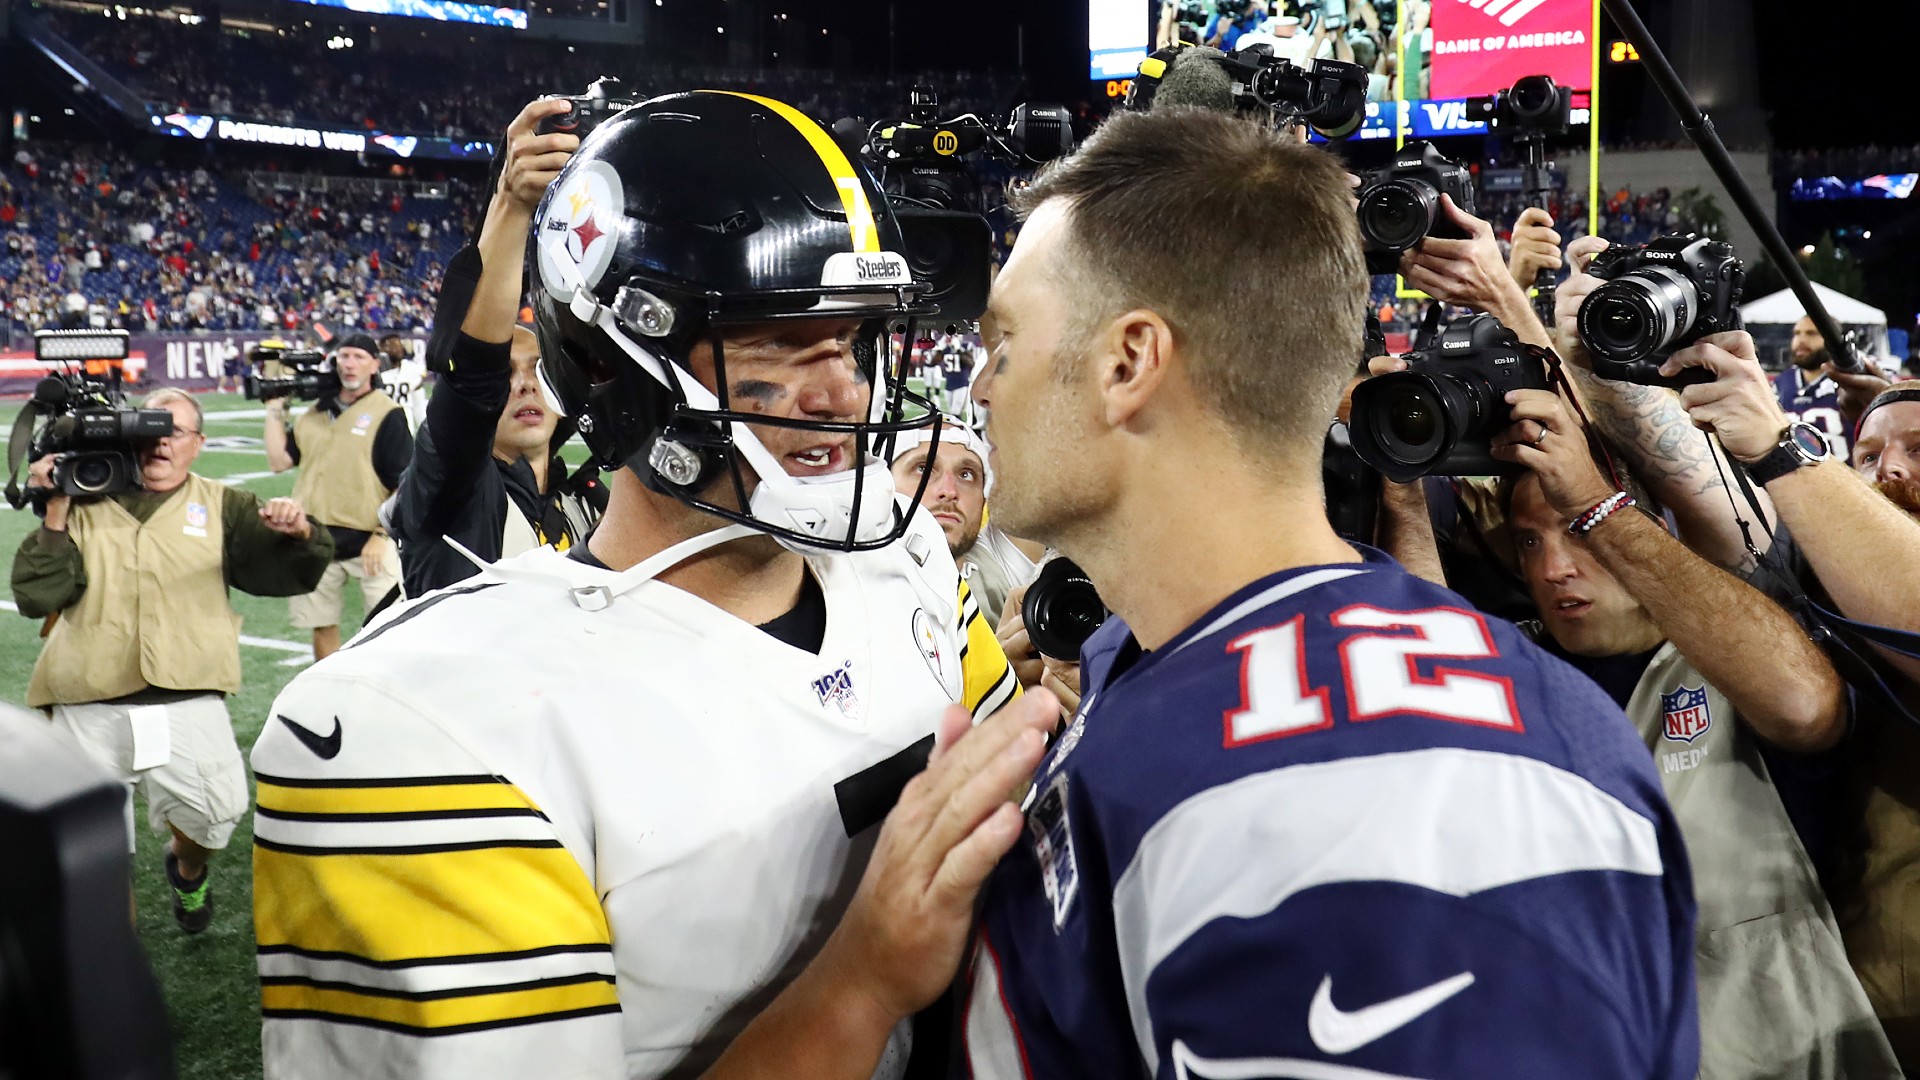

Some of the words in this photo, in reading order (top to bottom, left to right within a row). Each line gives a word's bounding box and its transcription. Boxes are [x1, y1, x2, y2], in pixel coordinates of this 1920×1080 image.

[1435, 38, 1480, 54] BANK
[1483, 36, 1506, 51] OF
[1507, 30, 1585, 49] AMERICA
[1321, 65, 1344, 73] SONY
[1031, 109, 1057, 118] Canon
[1421, 101, 1487, 130] VIS
[218, 119, 321, 148] PATRIOTS
[322, 131, 366, 152] WIN
[937, 135, 955, 151] DD
[912, 167, 939, 175] Canon
[1397, 159, 1422, 168] Canon
[1645, 251, 1677, 260] SONY
[856, 255, 902, 281] Steelers
[1442, 340, 1471, 349] Canon
[166, 342, 224, 379] NEW
[943, 353, 961, 373] 51
[1222, 603, 1525, 749] 12
[1666, 706, 1707, 736] NFL
